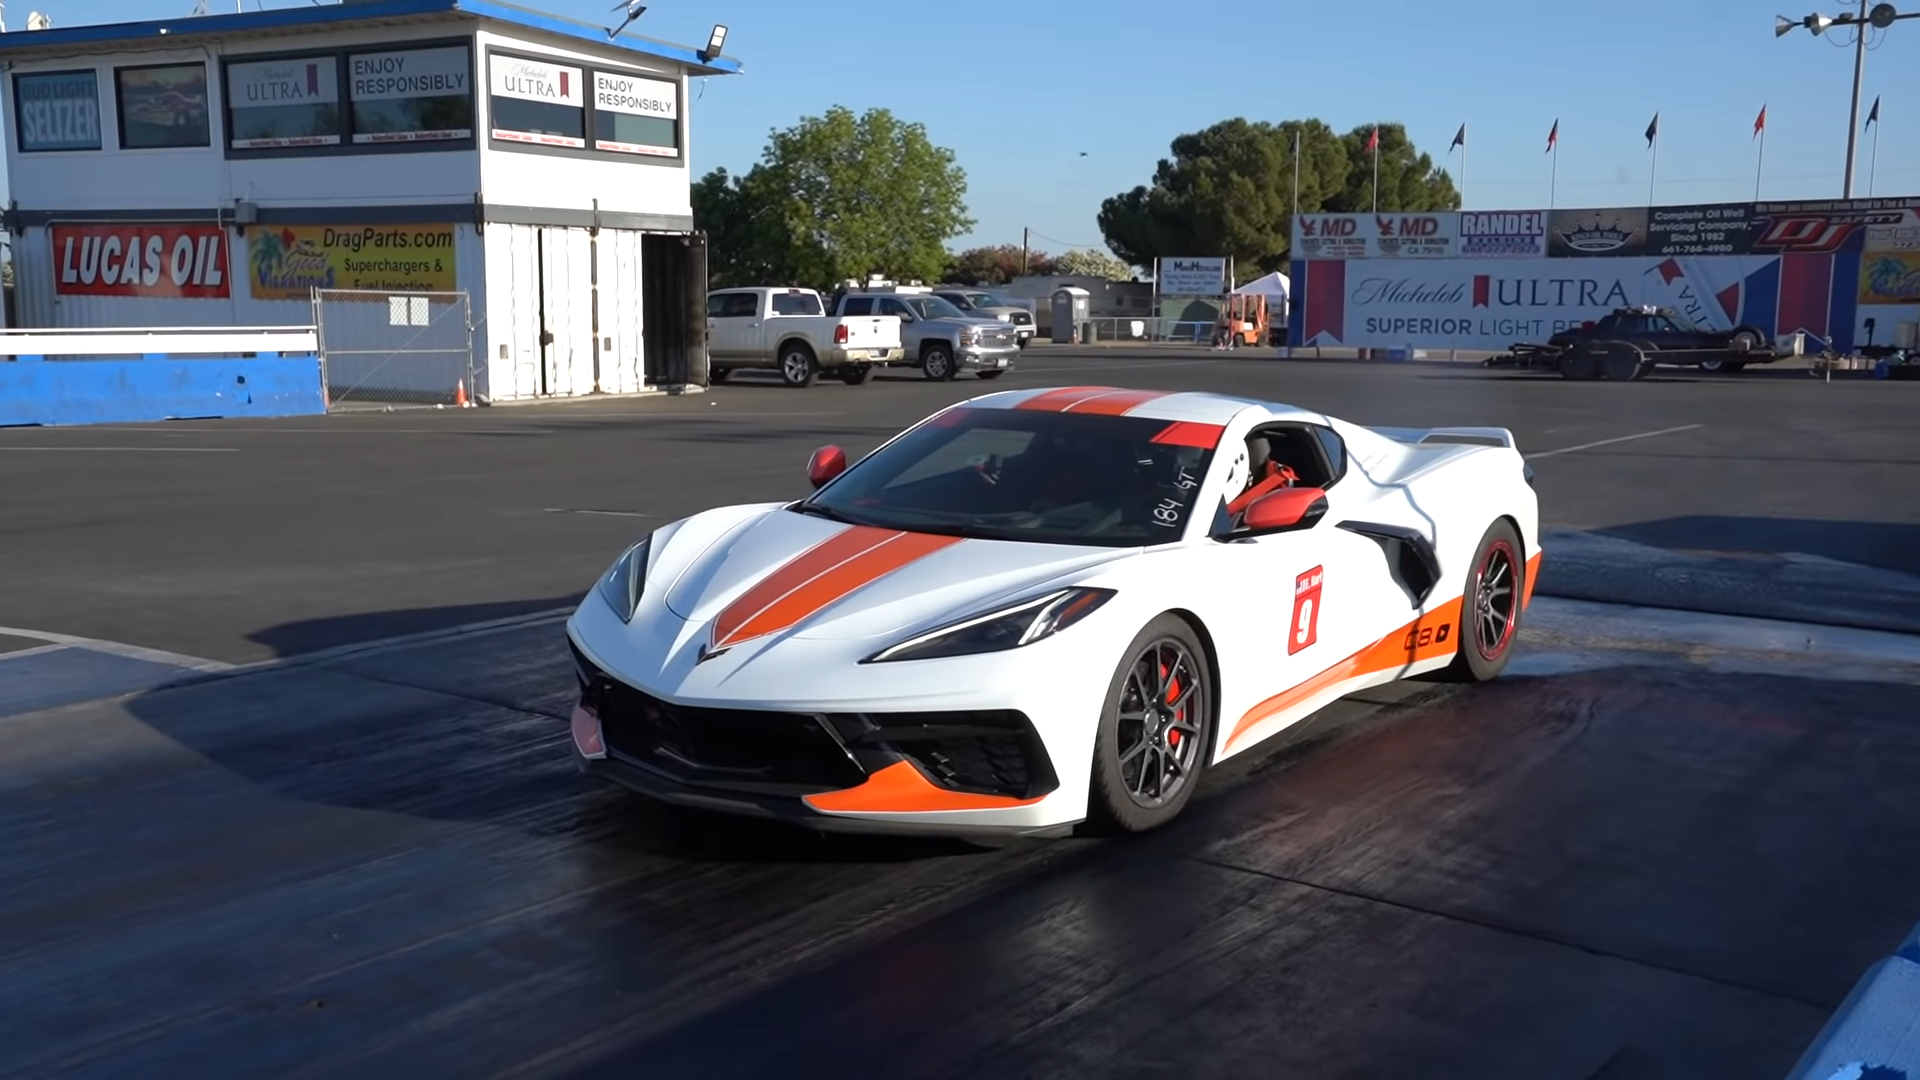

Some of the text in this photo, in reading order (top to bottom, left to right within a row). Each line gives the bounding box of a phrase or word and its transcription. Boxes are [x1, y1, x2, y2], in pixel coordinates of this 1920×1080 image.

[354, 57, 405, 75] ENJOY
[23, 81, 94, 99] BUD LIGHT
[246, 81, 303, 101] ULTRA
[355, 73, 464, 95] RESPONSIBLY
[505, 75, 556, 97] ULTRA
[598, 78, 633, 93] ENJOY
[598, 93, 672, 113] RESPONSIBLY
[24, 99, 99, 143] SELTZER
[1654, 209, 1745, 221] Complete Oil Well
[1829, 214, 1900, 224] SAFETY
[1320, 218, 1357, 236] MD
[1398, 218, 1438, 236] MD
[1461, 213, 1544, 237] RANDEL
[1649, 223, 1695, 233] Servicing
[323, 228, 453, 250] DragParts.com
[1670, 232, 1725, 242] Since 1982
[62, 235, 222, 286] LUCAS OIL
[344, 258, 443, 274] Superchargers &
[354, 279, 379, 290] Fuel
[1351, 277, 1630, 307] Michelob ULTRA
[1366, 317, 1472, 335] SUPERIOR
[1480, 319, 1544, 336] LIGHT
[1152, 498, 1183, 527] 184
[1296, 598, 1313, 645] 9
